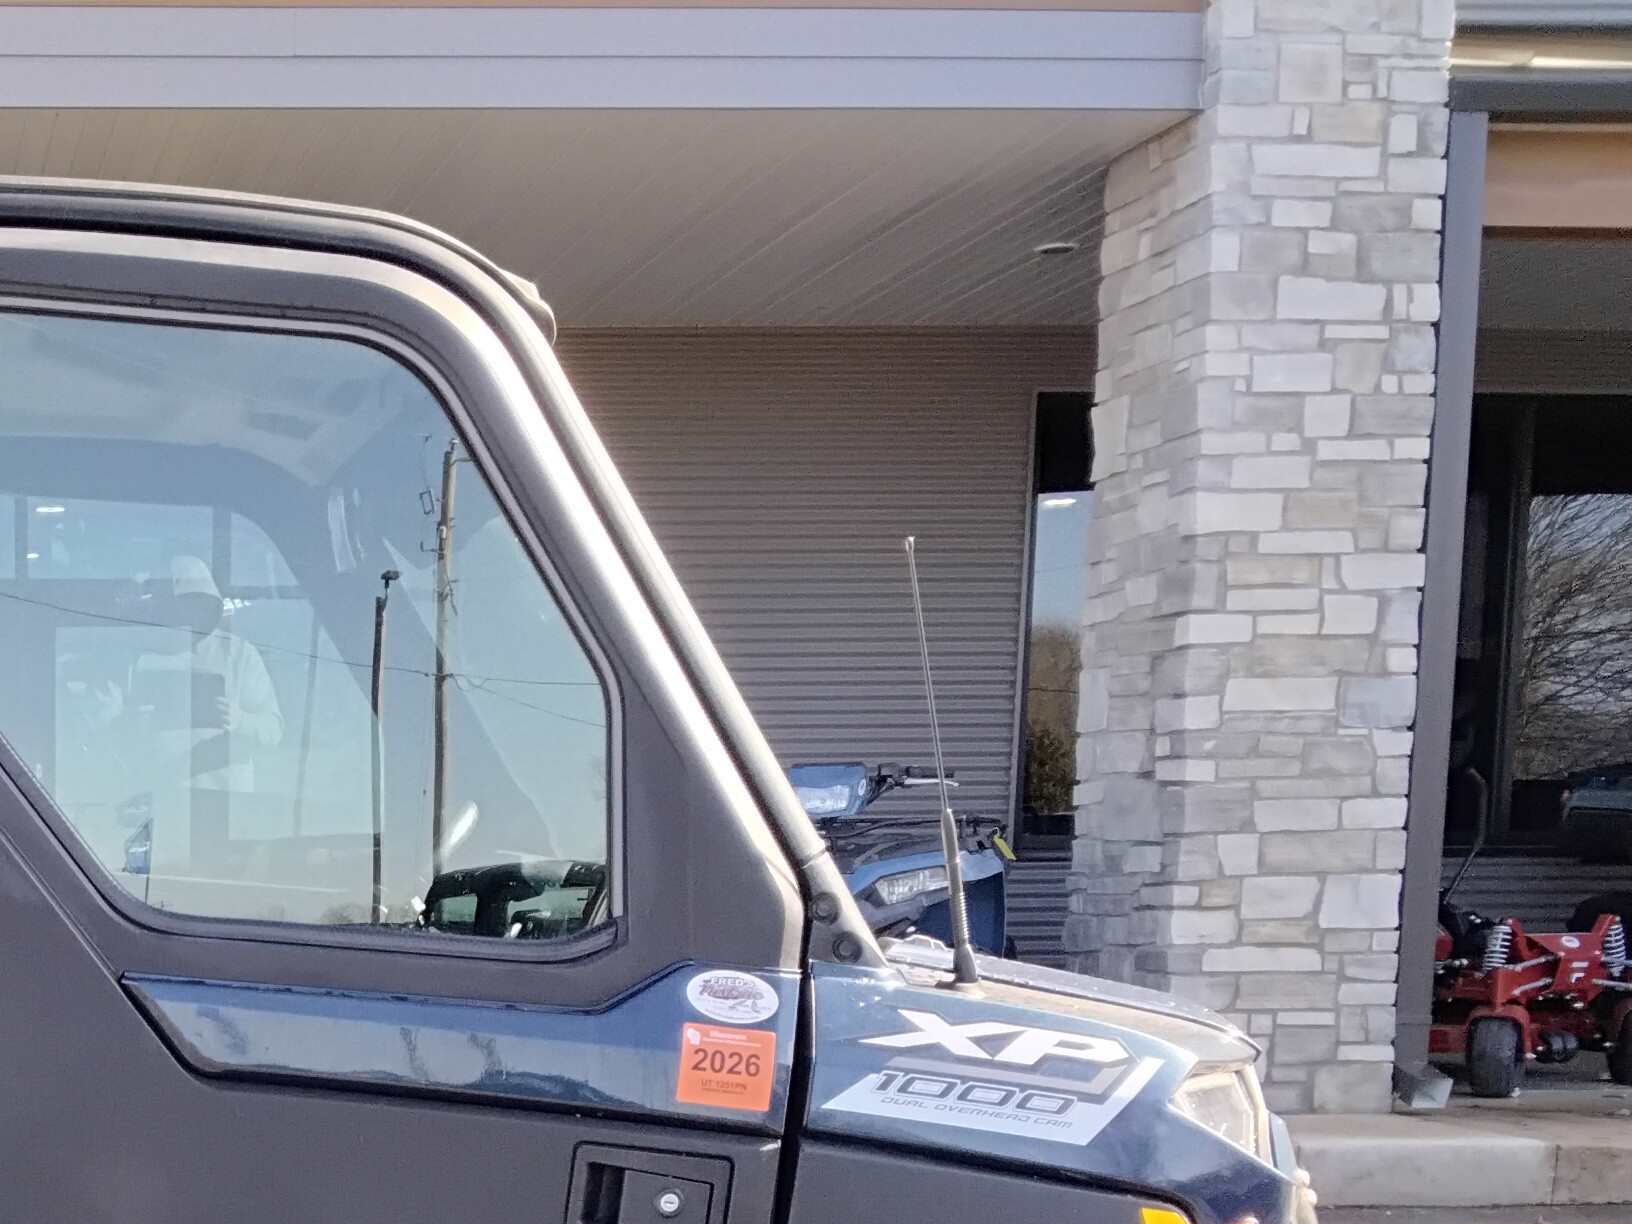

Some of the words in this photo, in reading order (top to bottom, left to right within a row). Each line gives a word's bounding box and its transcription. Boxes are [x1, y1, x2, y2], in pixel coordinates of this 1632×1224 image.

[858, 1008, 1130, 1066] XP
[691, 1048, 761, 1077] 2026
[871, 1070, 1077, 1117] 1000
[880, 1097, 929, 1110] DUAL
[937, 1104, 1031, 1123] OVERHEAD
[1033, 1116, 1074, 1129] CAM
